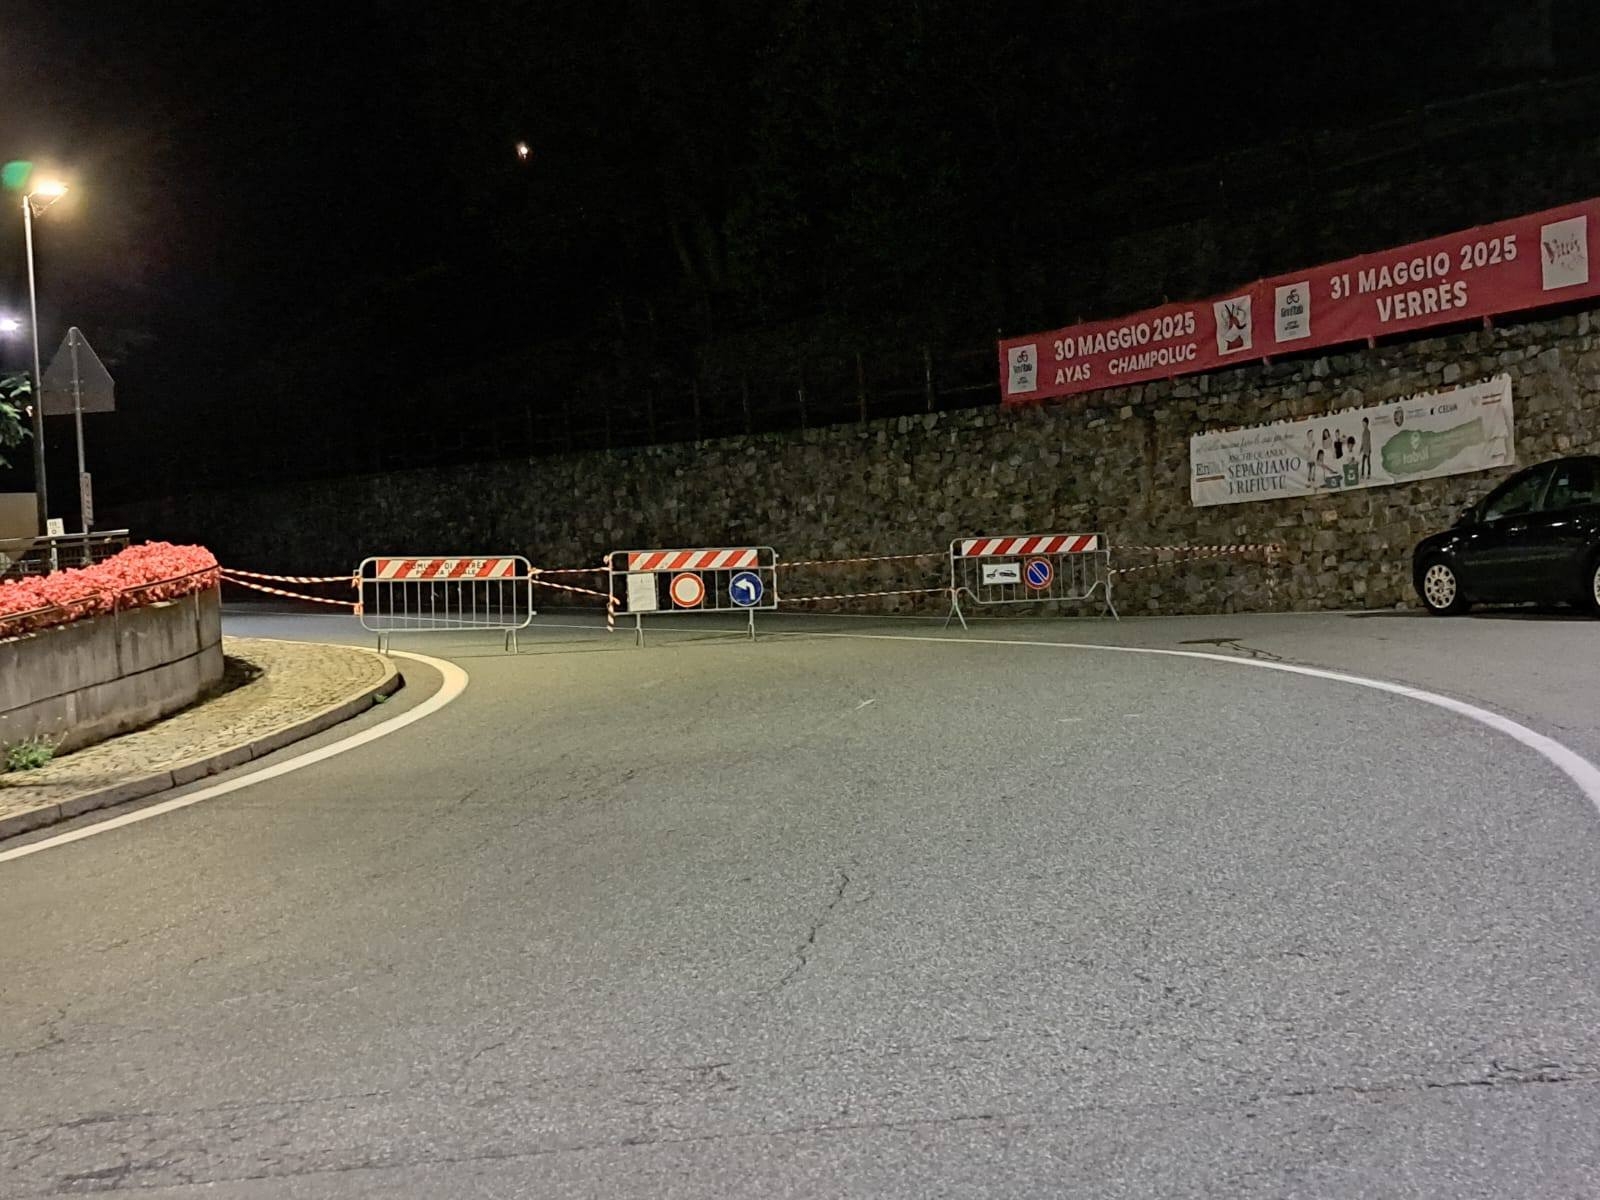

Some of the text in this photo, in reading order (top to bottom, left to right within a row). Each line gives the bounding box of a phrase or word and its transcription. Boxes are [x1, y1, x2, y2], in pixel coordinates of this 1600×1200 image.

[1329, 273, 1350, 300] 31
[1358, 252, 1451, 294] MAGGIO
[1460, 234, 1518, 272] 2025
[1376, 278, 1468, 322] VERRÈS
[1054, 311, 1196, 361] 30 MAGGIO 2025
[1055, 363, 1091, 385] AYAS
[1108, 343, 1197, 375] CHAMPOLUC
[1228, 457, 1301, 479] SEPARIAMO
